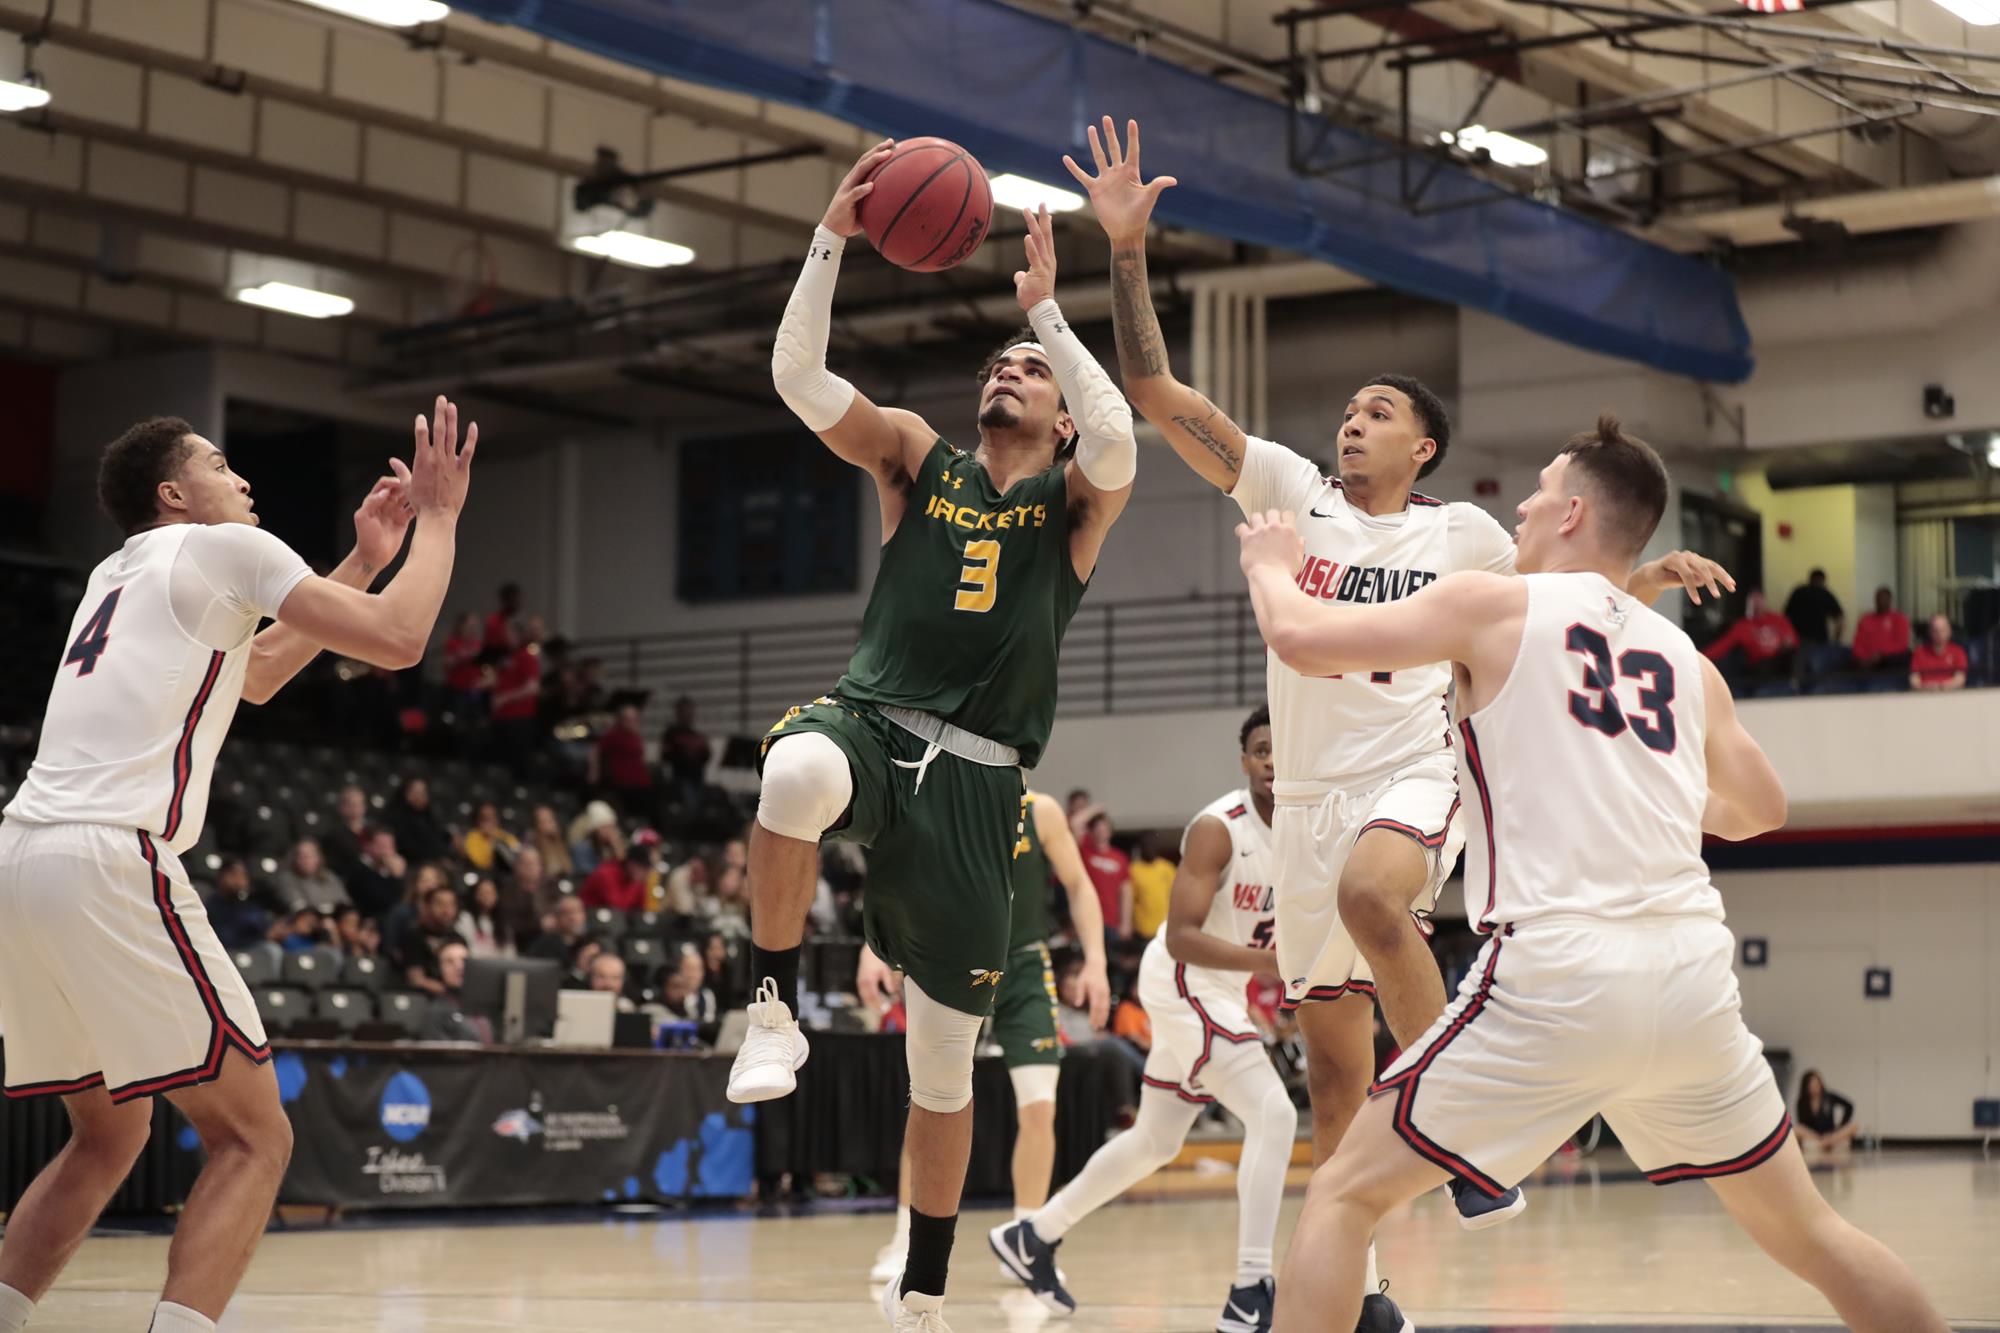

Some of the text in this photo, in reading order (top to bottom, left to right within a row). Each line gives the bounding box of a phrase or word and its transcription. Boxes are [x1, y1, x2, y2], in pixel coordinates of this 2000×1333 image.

[925, 494, 1046, 531] JACKETS
[954, 539, 1000, 613] 3
[64, 584, 125, 678] 4
[1565, 627, 1676, 755] 33
